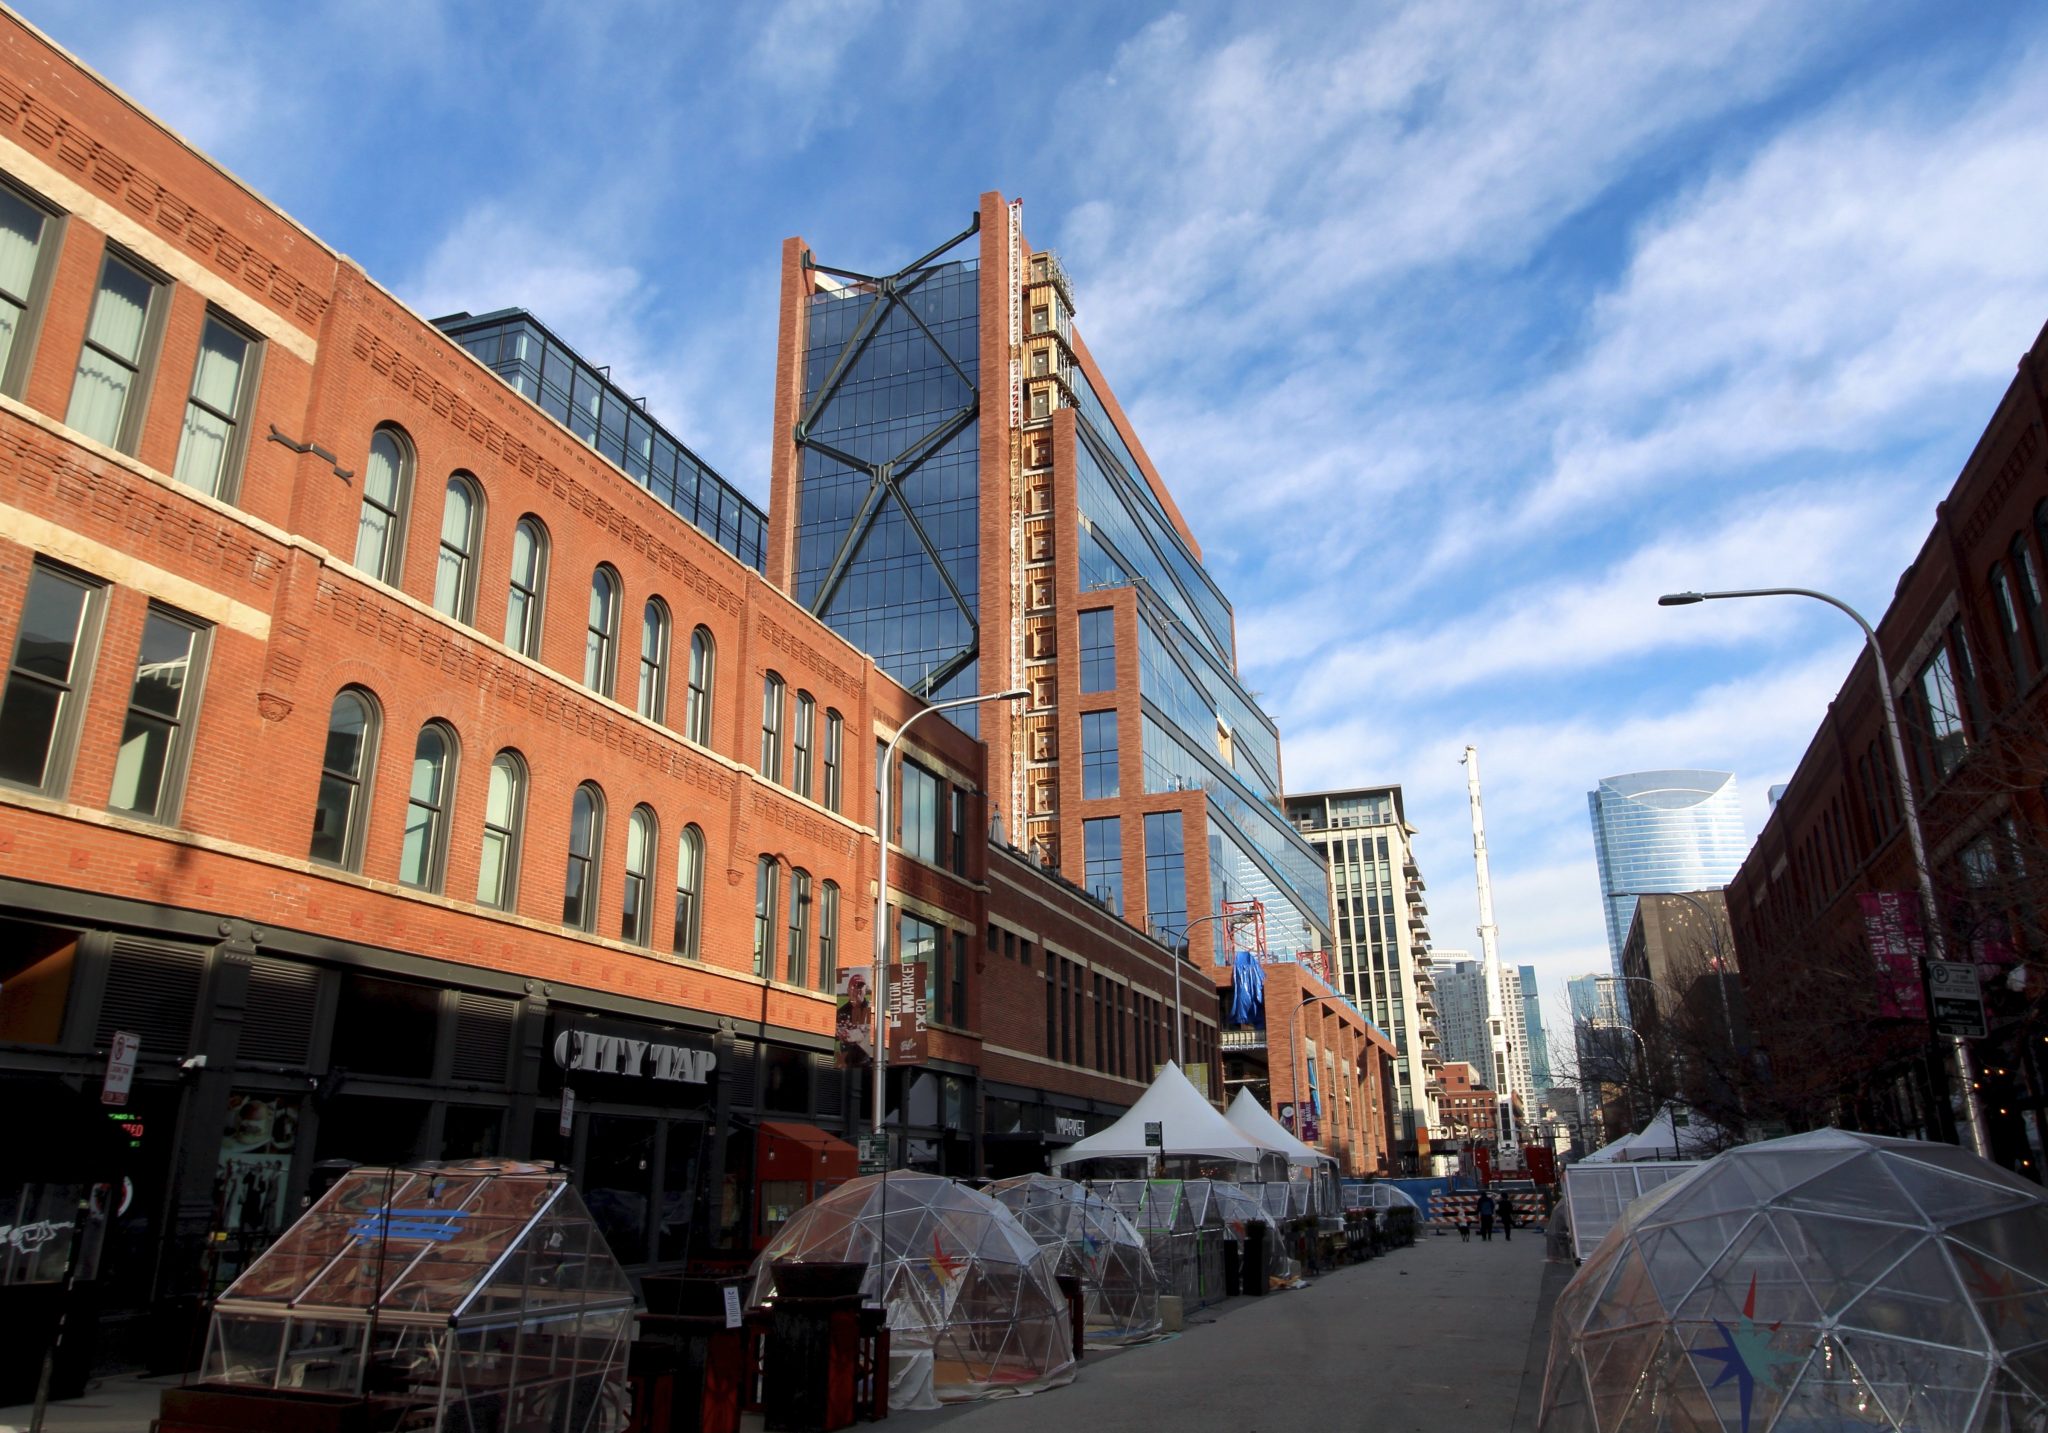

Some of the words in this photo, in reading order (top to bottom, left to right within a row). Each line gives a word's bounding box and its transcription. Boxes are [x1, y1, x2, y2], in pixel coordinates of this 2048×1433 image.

[889, 982, 902, 1028] FULTON
[901, 962, 915, 1014] MARKET
[915, 998, 927, 1032] EXPO
[554, 1029, 650, 1077] CITY
[650, 1043, 718, 1085] TAP
[1055, 1116, 1086, 1138] MARKET
